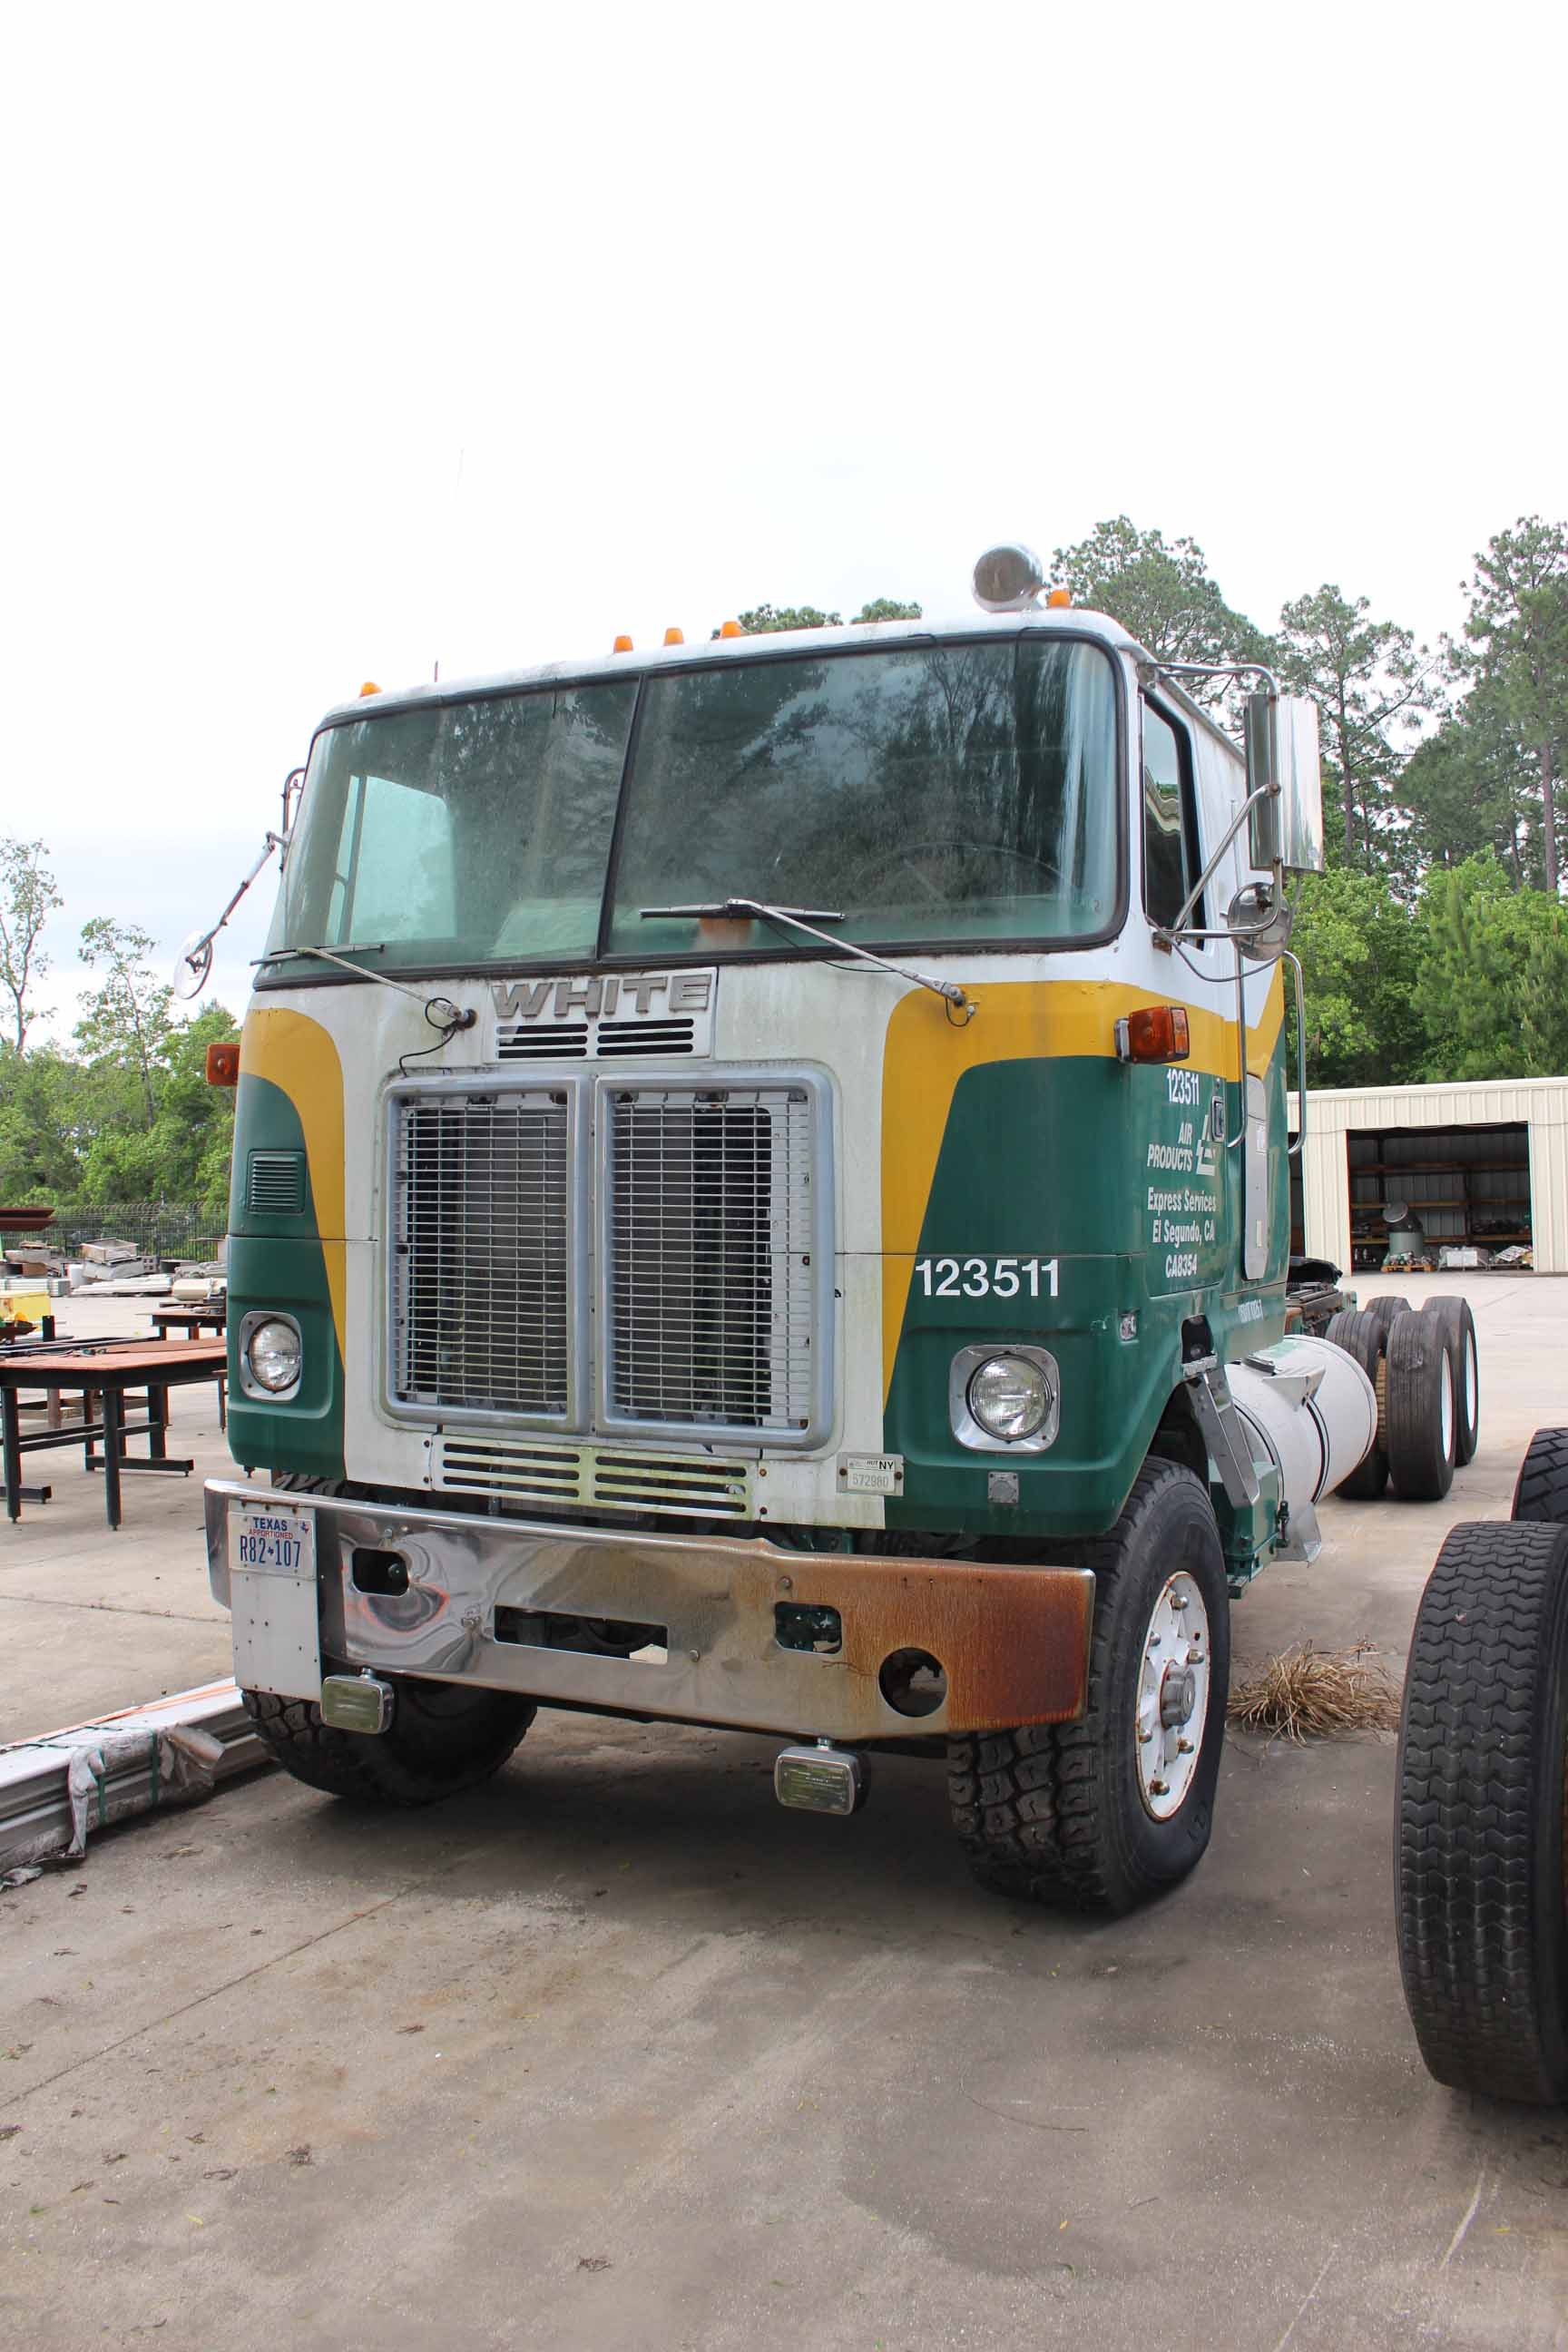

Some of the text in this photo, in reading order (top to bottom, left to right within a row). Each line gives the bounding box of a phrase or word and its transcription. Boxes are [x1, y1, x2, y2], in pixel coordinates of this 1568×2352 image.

[491, 974, 712, 1017] WHITE
[1166, 1068, 1200, 1105] 123511
[1178, 1122, 1193, 1145] AIR
[1147, 1143, 1193, 1172] PRODUCTS
[1147, 1187, 1217, 1217] Express Services
[1152, 1219, 1215, 1249] El Segundo, CA
[915, 1258, 1060, 1298] 123511
[879, 1460, 894, 1470] NY
[248, 1528, 294, 1541] APPORTIONED
[252, 1516, 288, 1532] TEXAS
